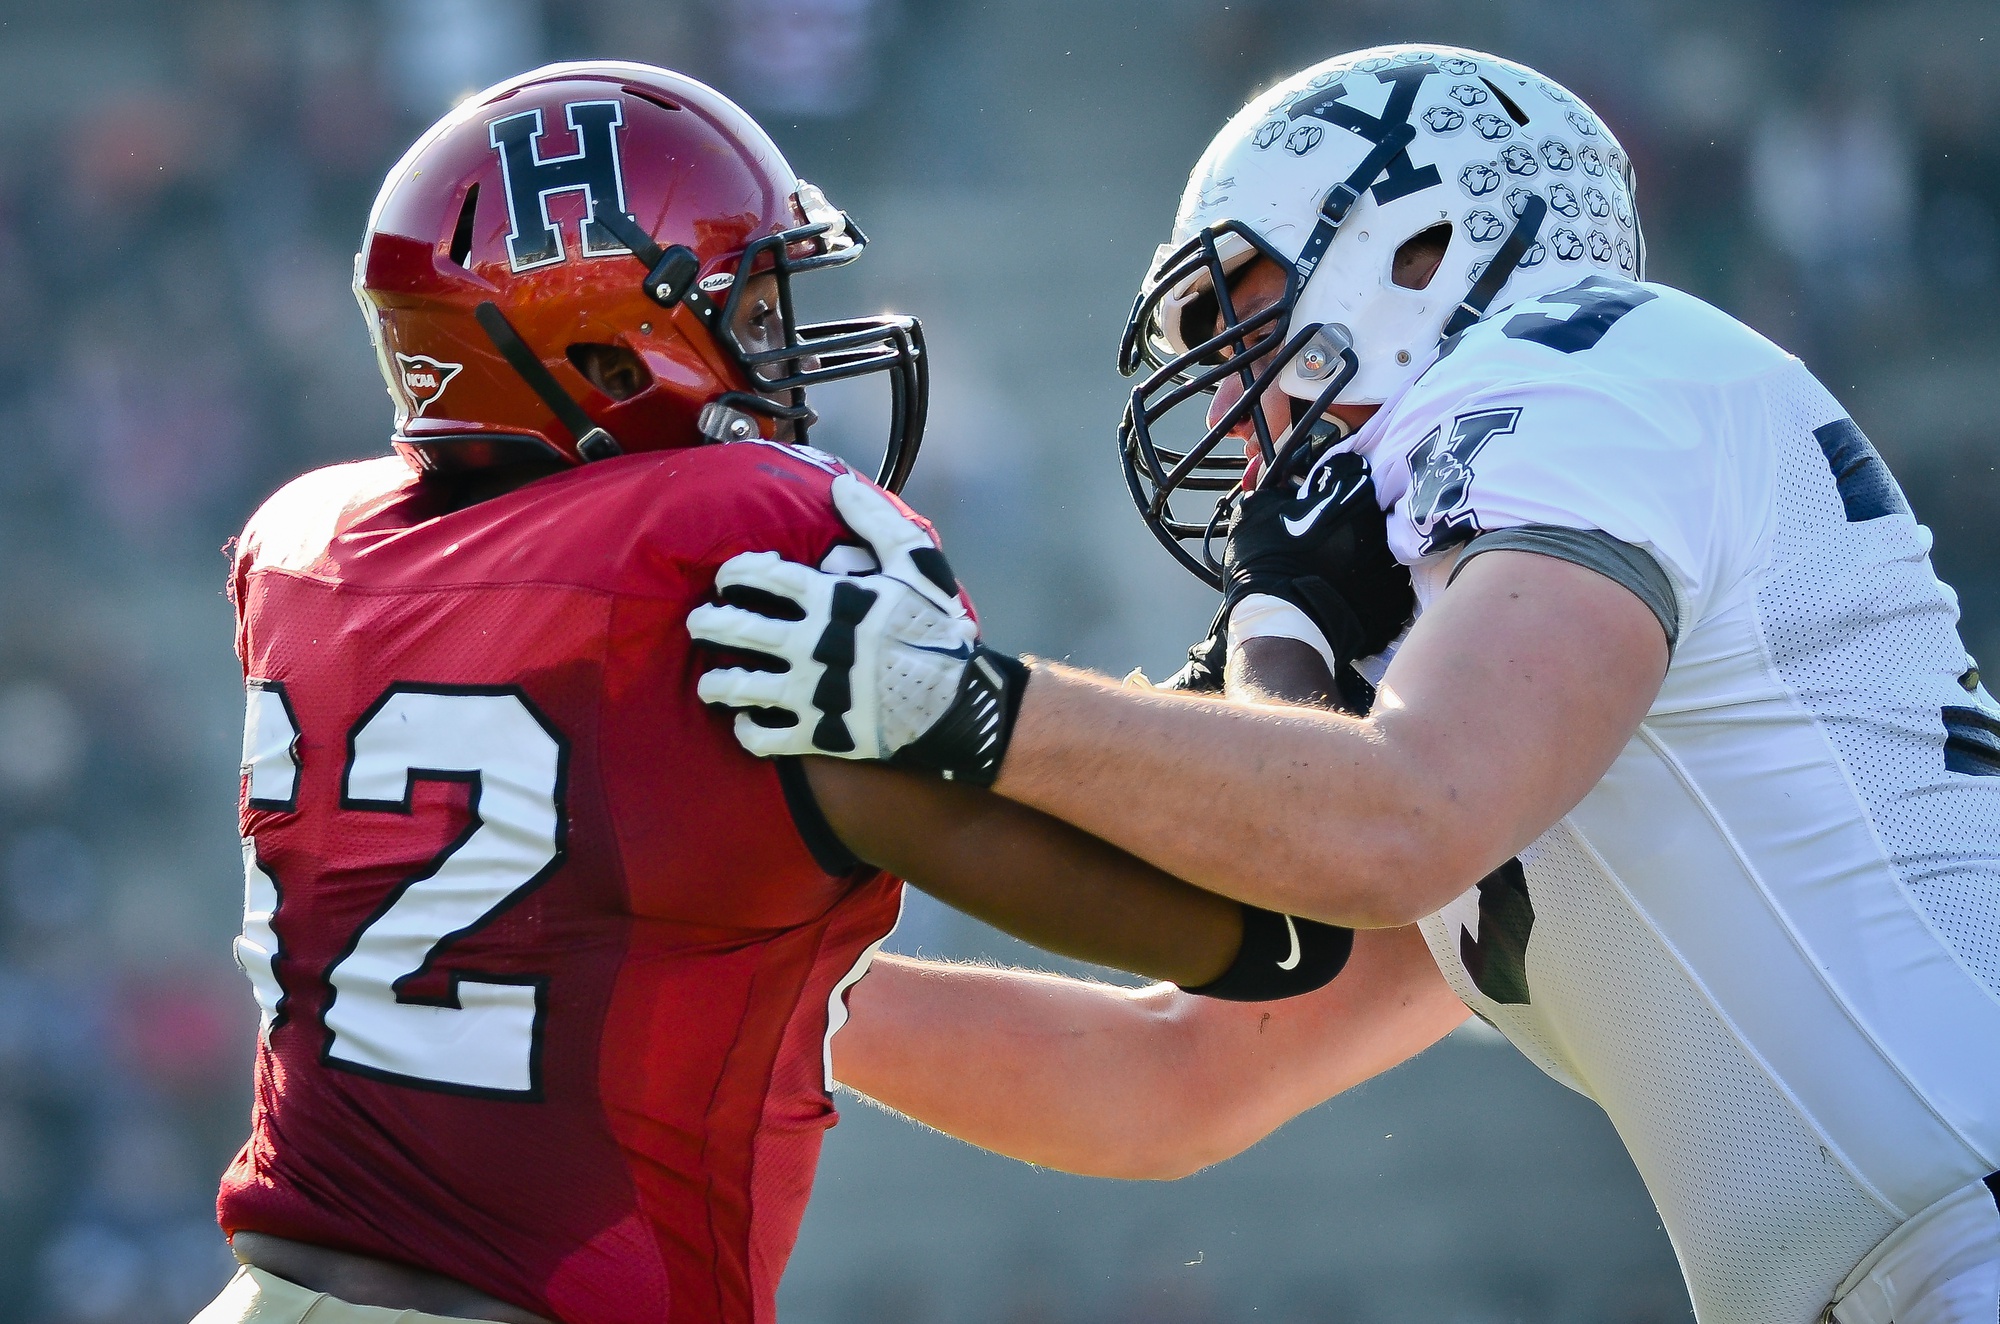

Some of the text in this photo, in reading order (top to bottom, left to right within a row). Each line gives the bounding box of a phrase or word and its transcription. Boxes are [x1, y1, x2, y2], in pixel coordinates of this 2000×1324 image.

[490, 100, 635, 272] H
[1287, 63, 1442, 206] Y
[406, 373, 436, 388] NCAA
